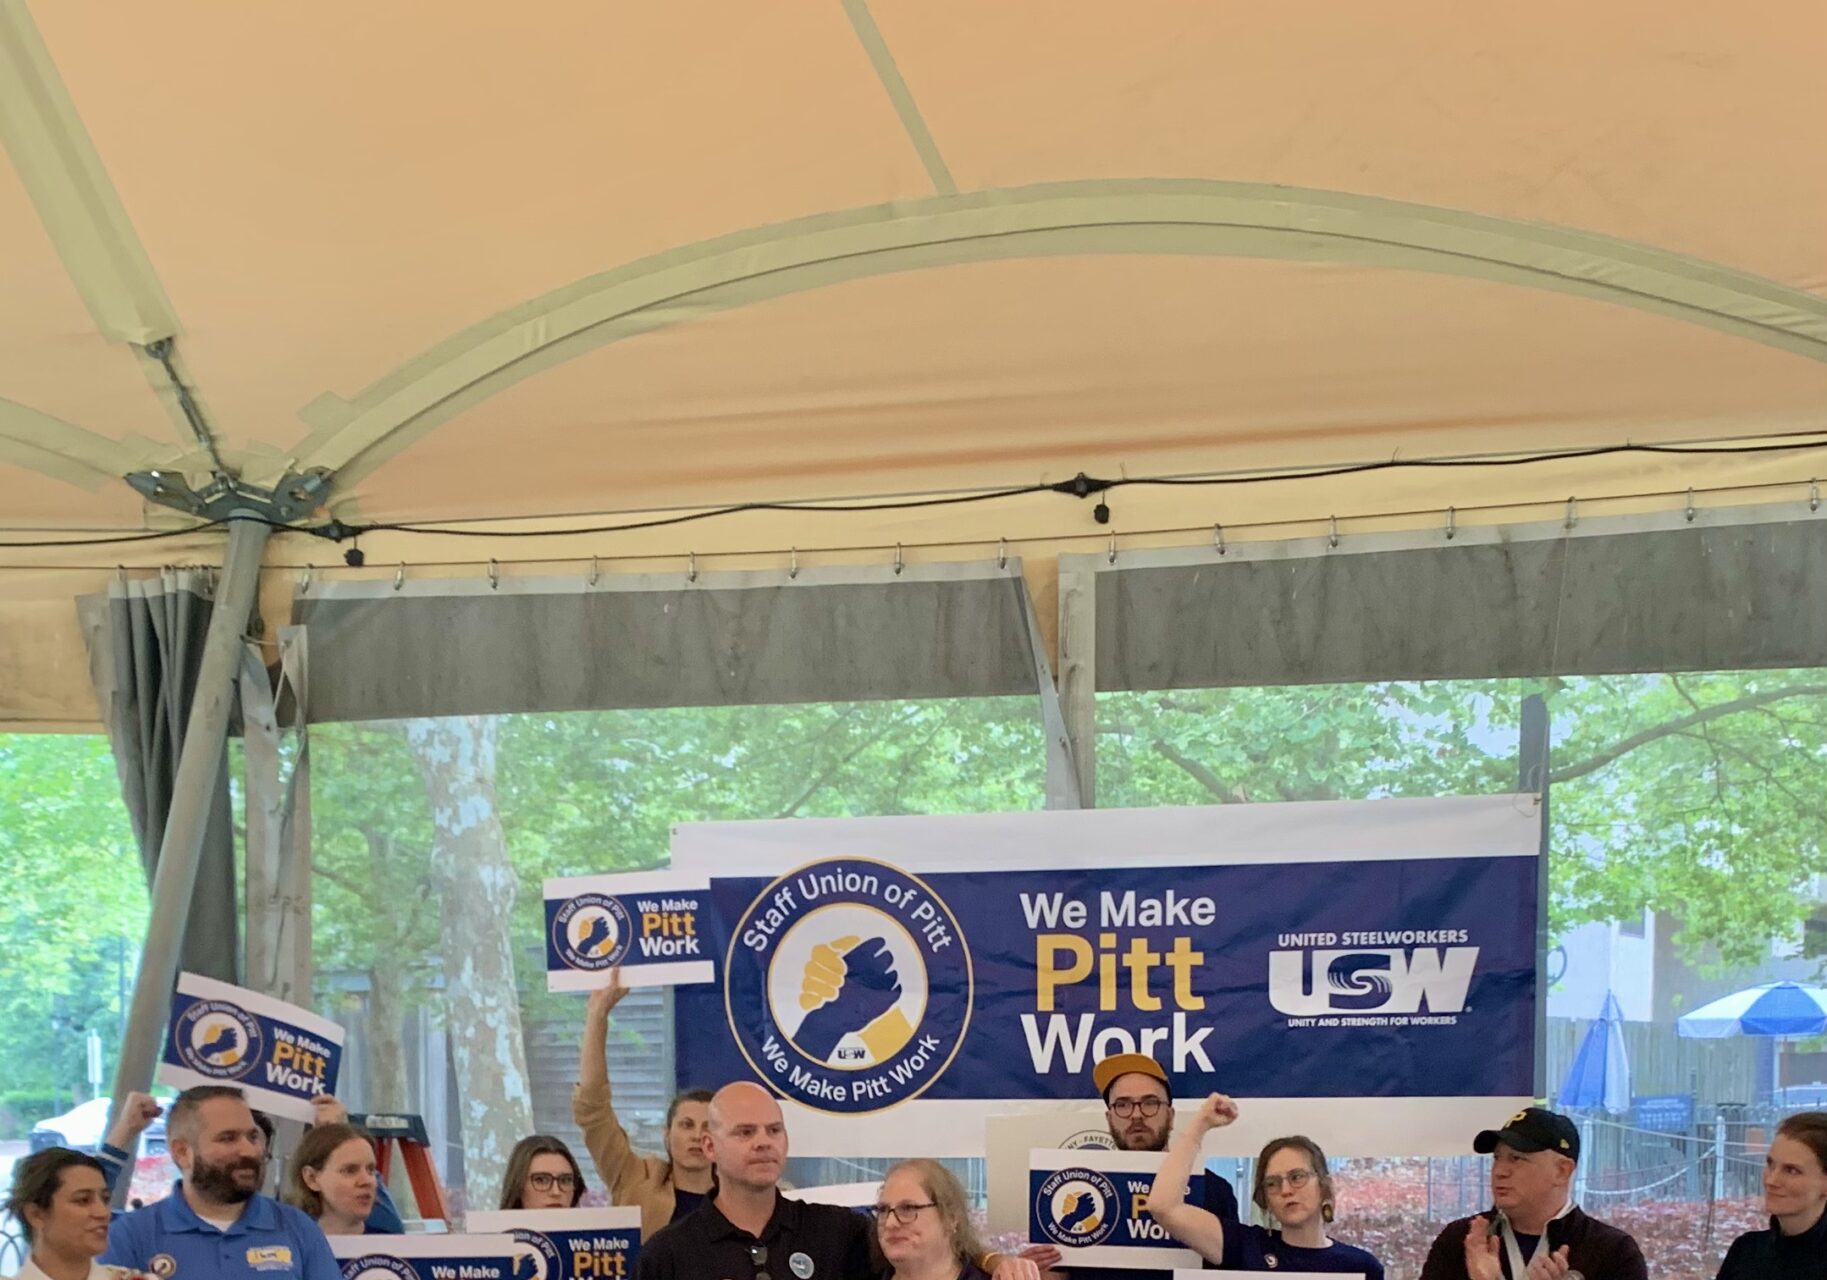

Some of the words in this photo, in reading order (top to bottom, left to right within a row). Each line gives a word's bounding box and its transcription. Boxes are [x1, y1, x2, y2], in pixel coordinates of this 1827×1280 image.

[637, 901, 659, 913] We
[662, 899, 698, 911] Make
[744, 887, 793, 953] Staff
[798, 868, 878, 899] Union
[883, 883, 917, 905] of
[910, 900, 952, 953] Pitt
[1020, 893, 1087, 929] We
[1101, 890, 1216, 927] Make
[643, 913, 696, 937] Pitt
[1278, 933, 1336, 946] UNITED
[1342, 930, 1469, 945] STEELWORKERS
[639, 936, 700, 957] Work
[1036, 933, 1206, 1012] Pitt
[1268, 946, 1480, 1016] USW
[1288, 1017, 1315, 1027] UNITY
[1318, 1017, 1339, 1026] AND
[1341, 1017, 1388, 1026] STRENGTH
[1390, 1016, 1408, 1026] FOR
[1410, 1016, 1457, 1025] WORKERS
[273, 1027, 293, 1044] We
[297, 1035, 331, 1059] Make
[1020, 1012, 1216, 1073] Work
[272, 1041, 326, 1080] Pitt
[761, 1035, 789, 1073] We
[789, 1066, 846, 1101] Make
[852, 1078, 891, 1100] Pitt
[888, 1034, 940, 1089] Work
[266, 1063, 326, 1095] Work
[1043, 1173, 1063, 1196] Staff
[1063, 1170, 1090, 1180] Union
[1091, 1175, 1102, 1187] of
[1099, 1179, 1114, 1198] Pitt
[1128, 1181, 1149, 1194] We
[1047, 1223, 1059, 1237] We
[1057, 1232, 1077, 1245] Make
[1078, 1235, 1093, 1244] Pitt
[1092, 1223, 1109, 1239] Work
[1127, 1219, 1170, 1239] Wor
[568, 1239, 591, 1251] We
[593, 1237, 629, 1250] Make
[432, 1266, 455, 1279] We
[459, 1265, 500, 1279] Make
[574, 1251, 626, 1277] Pitt
